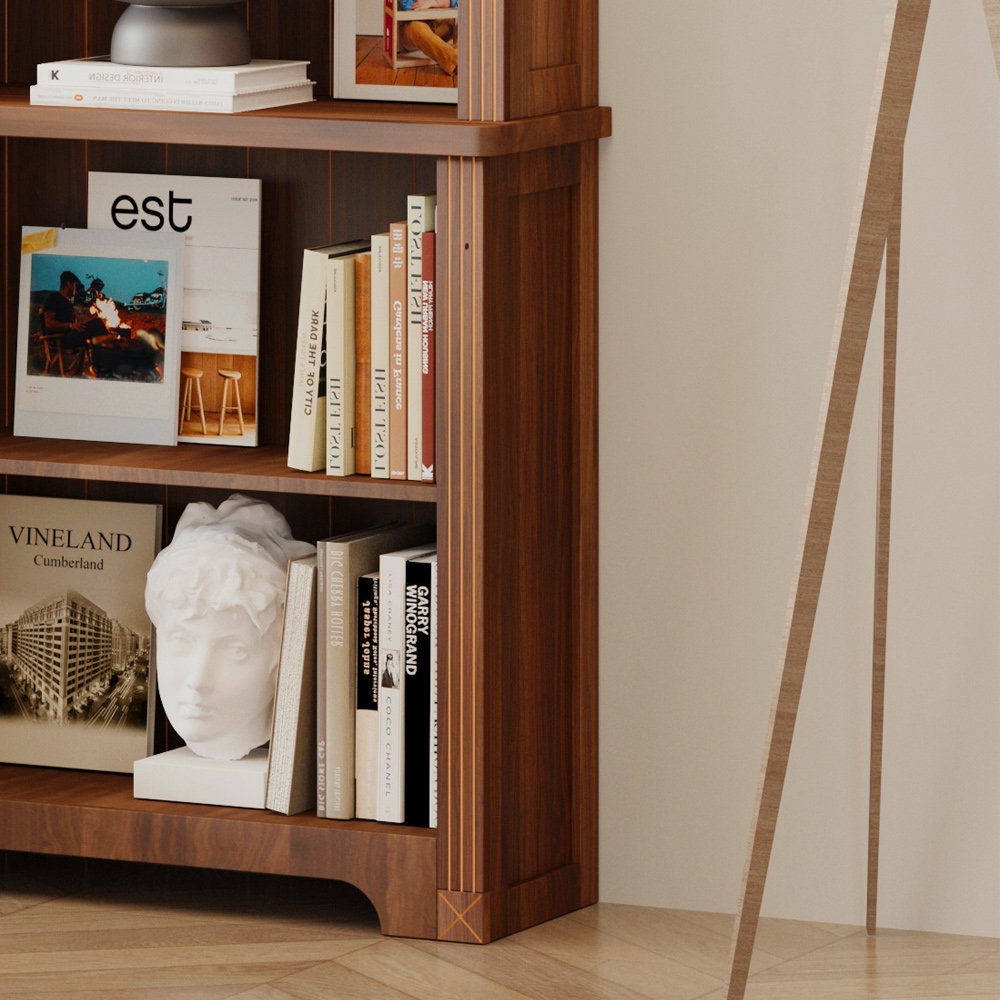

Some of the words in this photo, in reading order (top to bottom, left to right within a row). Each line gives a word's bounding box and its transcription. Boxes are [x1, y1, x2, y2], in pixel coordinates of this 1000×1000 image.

[51, 70, 59, 81] K
[110, 190, 193, 233] est
[8, 525, 132, 552] VINELAND
[33, 554, 104, 570] Cumberland
[417, 585, 429, 636] GARRY
[406, 584, 418, 676] WINOGRAND
